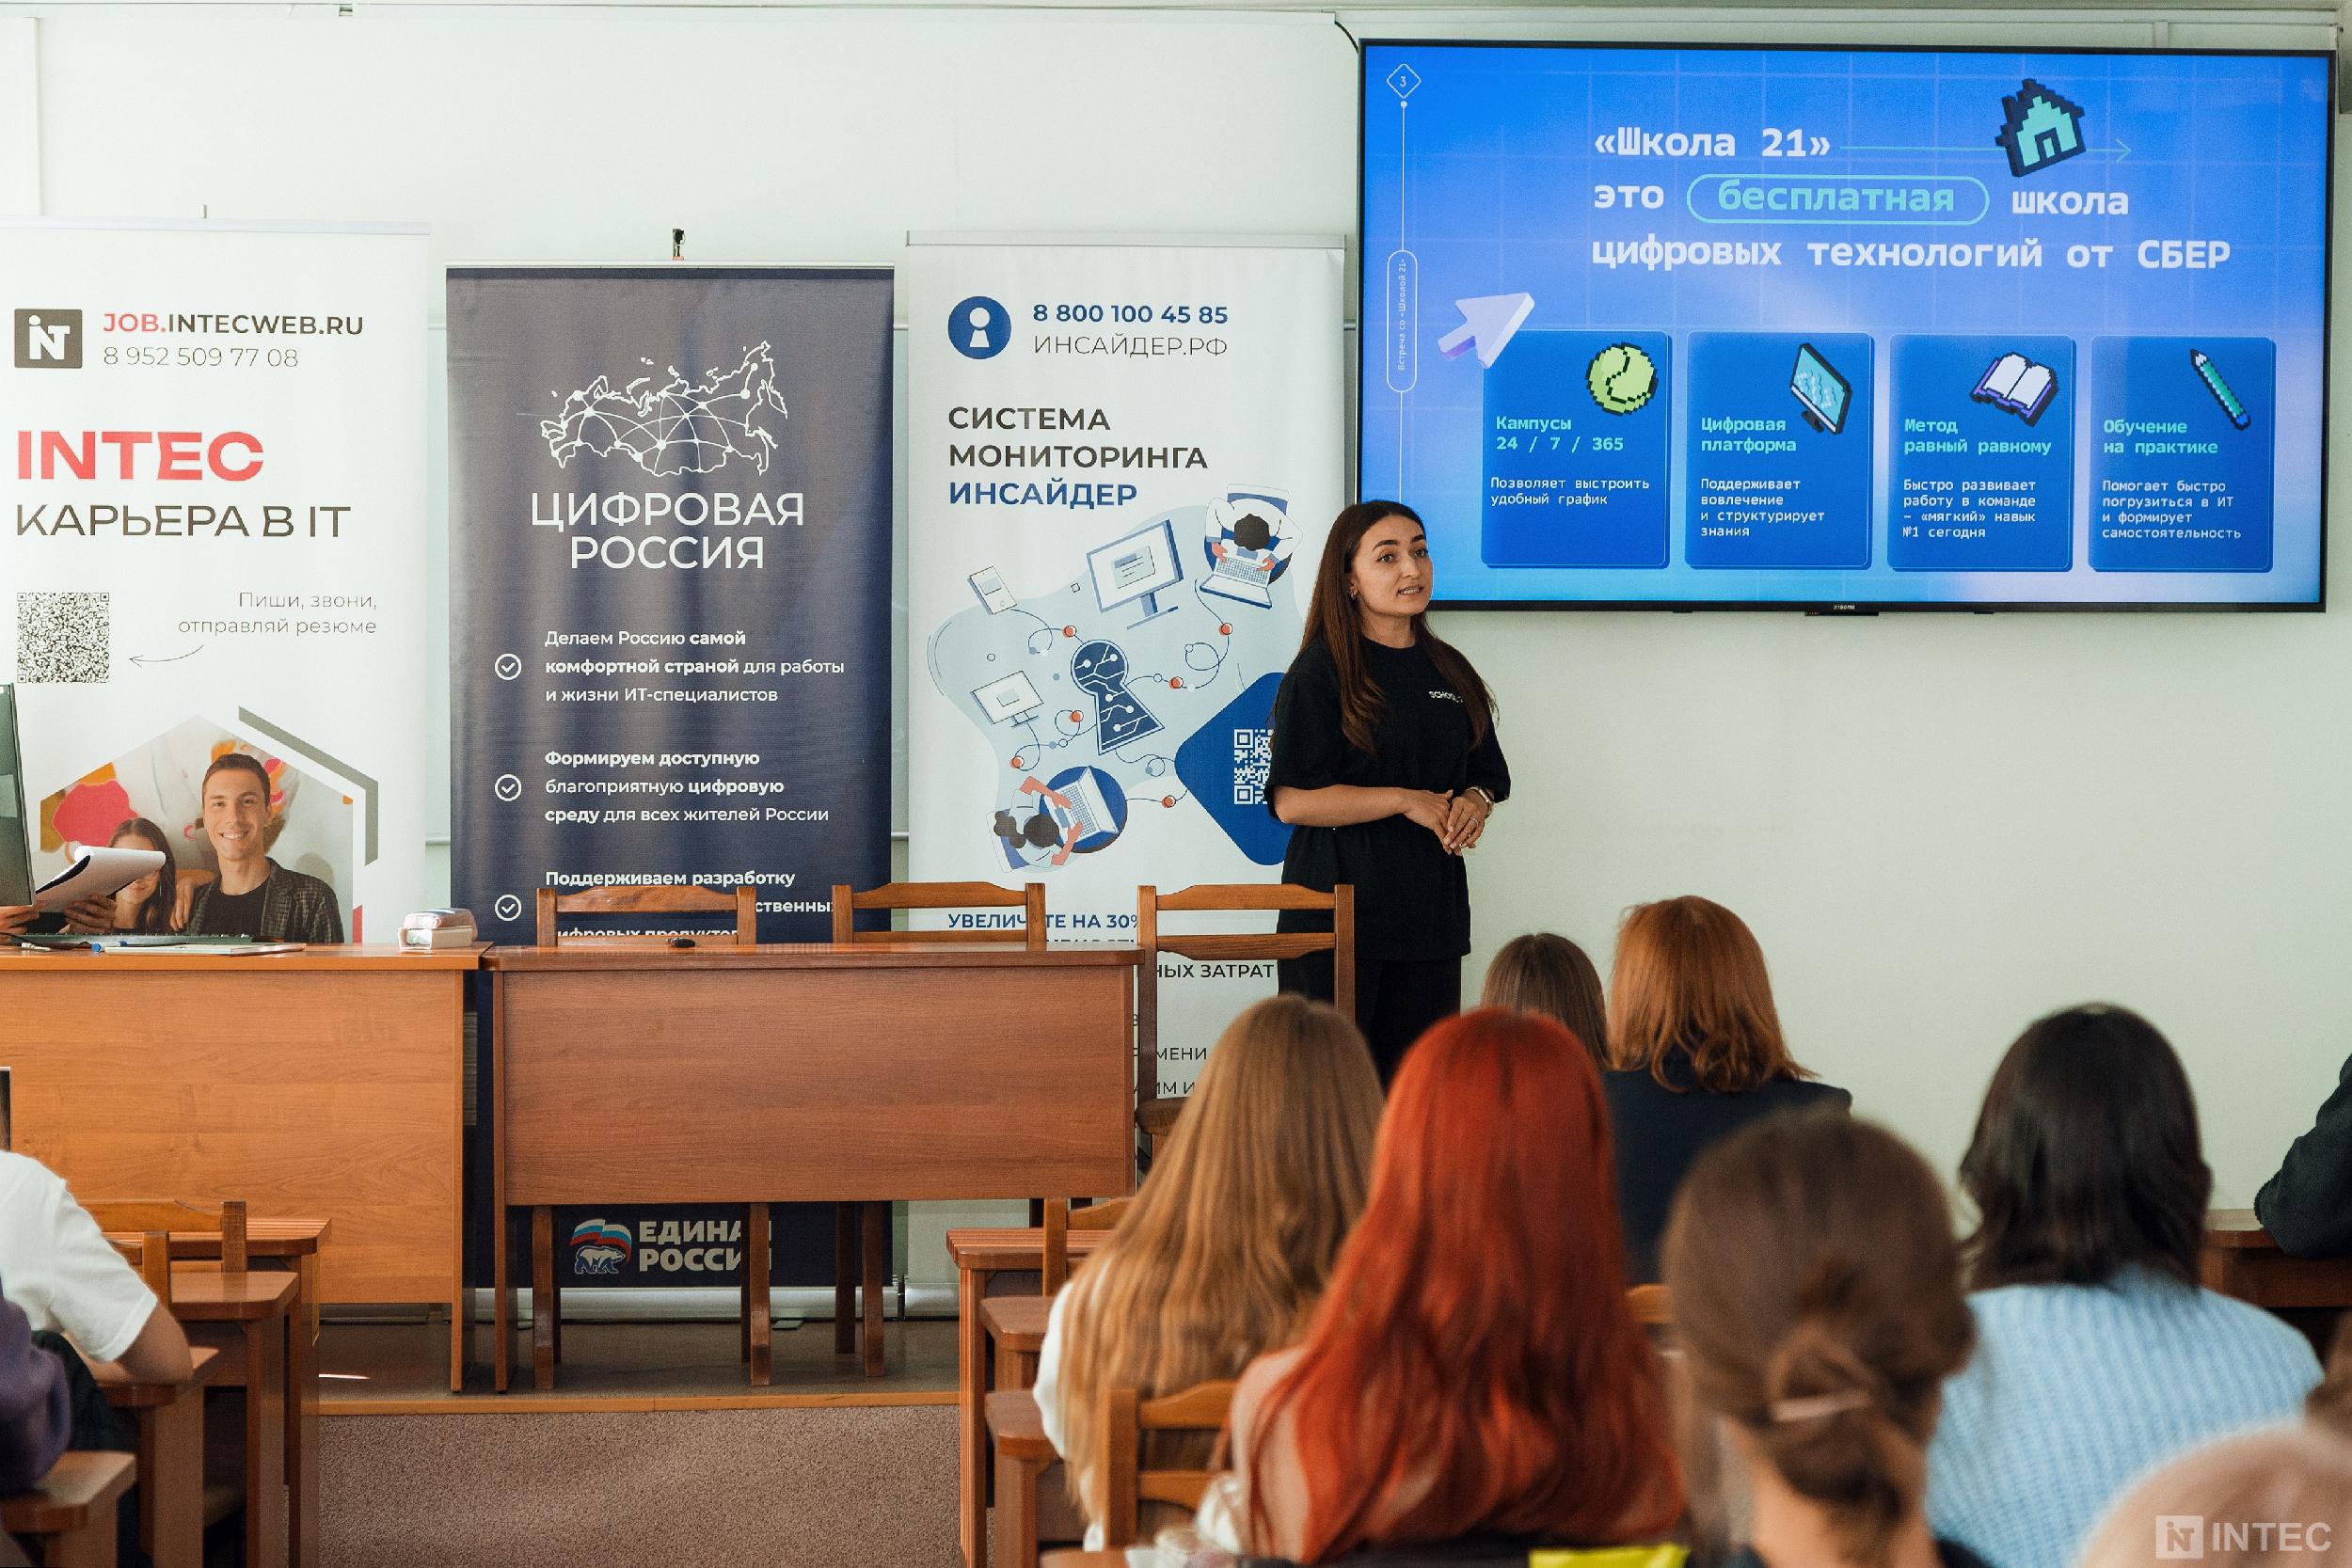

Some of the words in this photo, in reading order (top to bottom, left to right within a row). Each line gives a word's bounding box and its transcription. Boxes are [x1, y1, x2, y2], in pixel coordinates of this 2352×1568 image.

[1399, 74, 1407, 88] 3
[1595, 126, 1736, 157] «Школа
[1761, 127, 1831, 157] 21»
[1594, 184, 1664, 210] это
[1718, 179, 1955, 213] бесплатная
[2011, 191, 2129, 215] школа
[1592, 232, 1782, 272] цифровых
[1806, 237, 2042, 267] технологий
[2066, 244, 2114, 268] от
[2137, 239, 2231, 269] СБЕР
[1033, 304, 1048, 322] 8
[1056, 304, 1104, 323] 800
[1110, 305, 1153, 324] 100
[1160, 305, 1191, 325] 45
[1199, 306, 1229, 325] 85
[103, 313, 363, 336] JOB.INTECWEB.RU
[1035, 332, 1228, 358] ИНСАЙДЕР.РФ
[103, 346, 119, 365] 8
[126, 346, 169, 366] 952
[177, 347, 222, 367] 509
[230, 347, 260, 367] 77
[267, 348, 298, 368] 08
[948, 406, 1111, 431] СИСТЕМА
[1495, 415, 1573, 434] Кампусы
[1701, 416, 1788, 435] Цифровая
[1904, 418, 1959, 435] Метод
[2104, 420, 2187, 436] Обучение
[1496, 436, 1519, 450] 24
[1549, 436, 1562, 451] 7
[1592, 436, 1624, 451] 365
[1701, 436, 1797, 454] платформа
[1903, 437, 1968, 455] равный
[1977, 441, 2052, 456] равному
[2104, 442, 2124, 453] на
[2135, 442, 2219, 456] практике
[18, 430, 264, 483] INTEC
[949, 444, 1208, 469] МОНИТОРИНГА
[1490, 476, 1566, 489] Позволяет
[1575, 480, 1650, 491] выстроить
[1701, 478, 1801, 492] Поддерживает
[1903, 478, 1954, 493] Быстро
[1962, 481, 2037, 493] развивает
[2102, 480, 2169, 492] Помогает
[2176, 480, 2226, 494] быстро
[949, 477, 1137, 510] ИНСАЙДЕР
[1490, 492, 1549, 507] удобный
[1558, 492, 1608, 507] график
[1701, 496, 1784, 506] вовлечение
[1903, 494, 1954, 509] работу
[1962, 497, 1970, 507] в
[1978, 497, 2036, 508] команде
[532, 491, 803, 533] ЦИФРОВАЯ
[2102, 497, 2193, 510] погрузиться
[2201, 498, 2209, 508] в
[2217, 496, 2234, 507] ИТ
[17, 504, 250, 537] КАРЬЕРА
[262, 505, 294, 537] В
[310, 506, 352, 538] IT
[1700, 512, 1708, 521] и
[1717, 511, 1825, 524] структурирует
[1921, 510, 1986, 522] «мягкий»
[1994, 513, 2036, 522] навык
[2102, 513, 2110, 523] и
[2118, 511, 2193, 526] формирует
[1700, 527, 1751, 537] знания
[1928, 529, 1986, 540] сегодня
[2102, 529, 2242, 539] самостоятельность
[571, 534, 764, 570] РОССИЯ
[239, 592, 304, 610] Пиши,
[310, 595, 377, 610] звони,
[178, 617, 289, 636] отправляй
[296, 621, 377, 637] резюме
[544, 630, 613, 648] Делаем
[618, 630, 687, 646] Россию
[689, 629, 746, 646] самой
[545, 657, 660, 676] комфортной
[663, 657, 739, 676] страной
[742, 662, 776, 675] для
[780, 658, 845, 676] работы
[546, 690, 557, 702] и
[561, 689, 619, 702] жизни
[625, 687, 778, 704] ИТ-специалистов
[544, 751, 655, 768] Формируем
[659, 753, 760, 768] доступную
[545, 778, 684, 797] благоприятную
[688, 778, 785, 797] цифровую
[544, 810, 600, 825] среду
[603, 810, 636, 823] для
[641, 810, 680, 821] всех
[683, 807, 760, 821] жителей
[765, 807, 829, 821] России
[546, 871, 688, 888] Поддерживаем
[691, 870, 796, 888] разработку
[1073, 914, 1102, 928] НА
[1200, 964, 1275, 978] ЗАТРАТ
[639, 1247, 771, 1272] РОССИ
